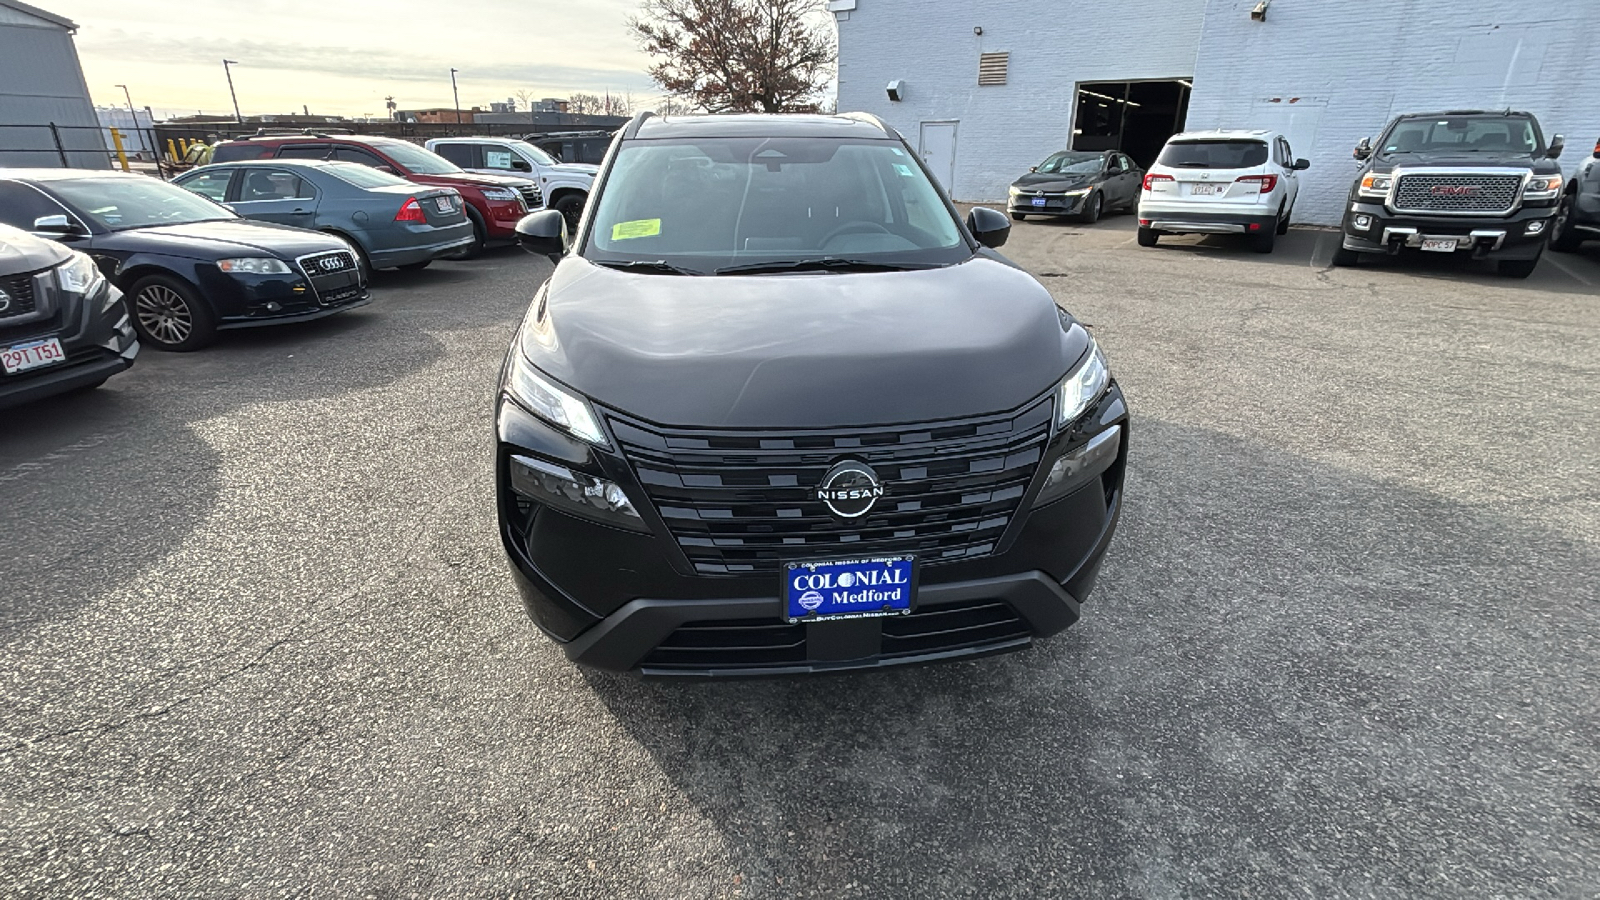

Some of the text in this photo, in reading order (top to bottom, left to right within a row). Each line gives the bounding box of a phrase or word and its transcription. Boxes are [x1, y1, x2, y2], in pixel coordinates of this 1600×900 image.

[1430, 186, 1481, 195] GMC
[3, 342, 63, 369] 29T T51
[818, 486, 884, 500] NISSAN
[801, 561, 834, 569] COLONIAL
[793, 568, 908, 591] COLONIAL
[832, 588, 901, 605] Medford
